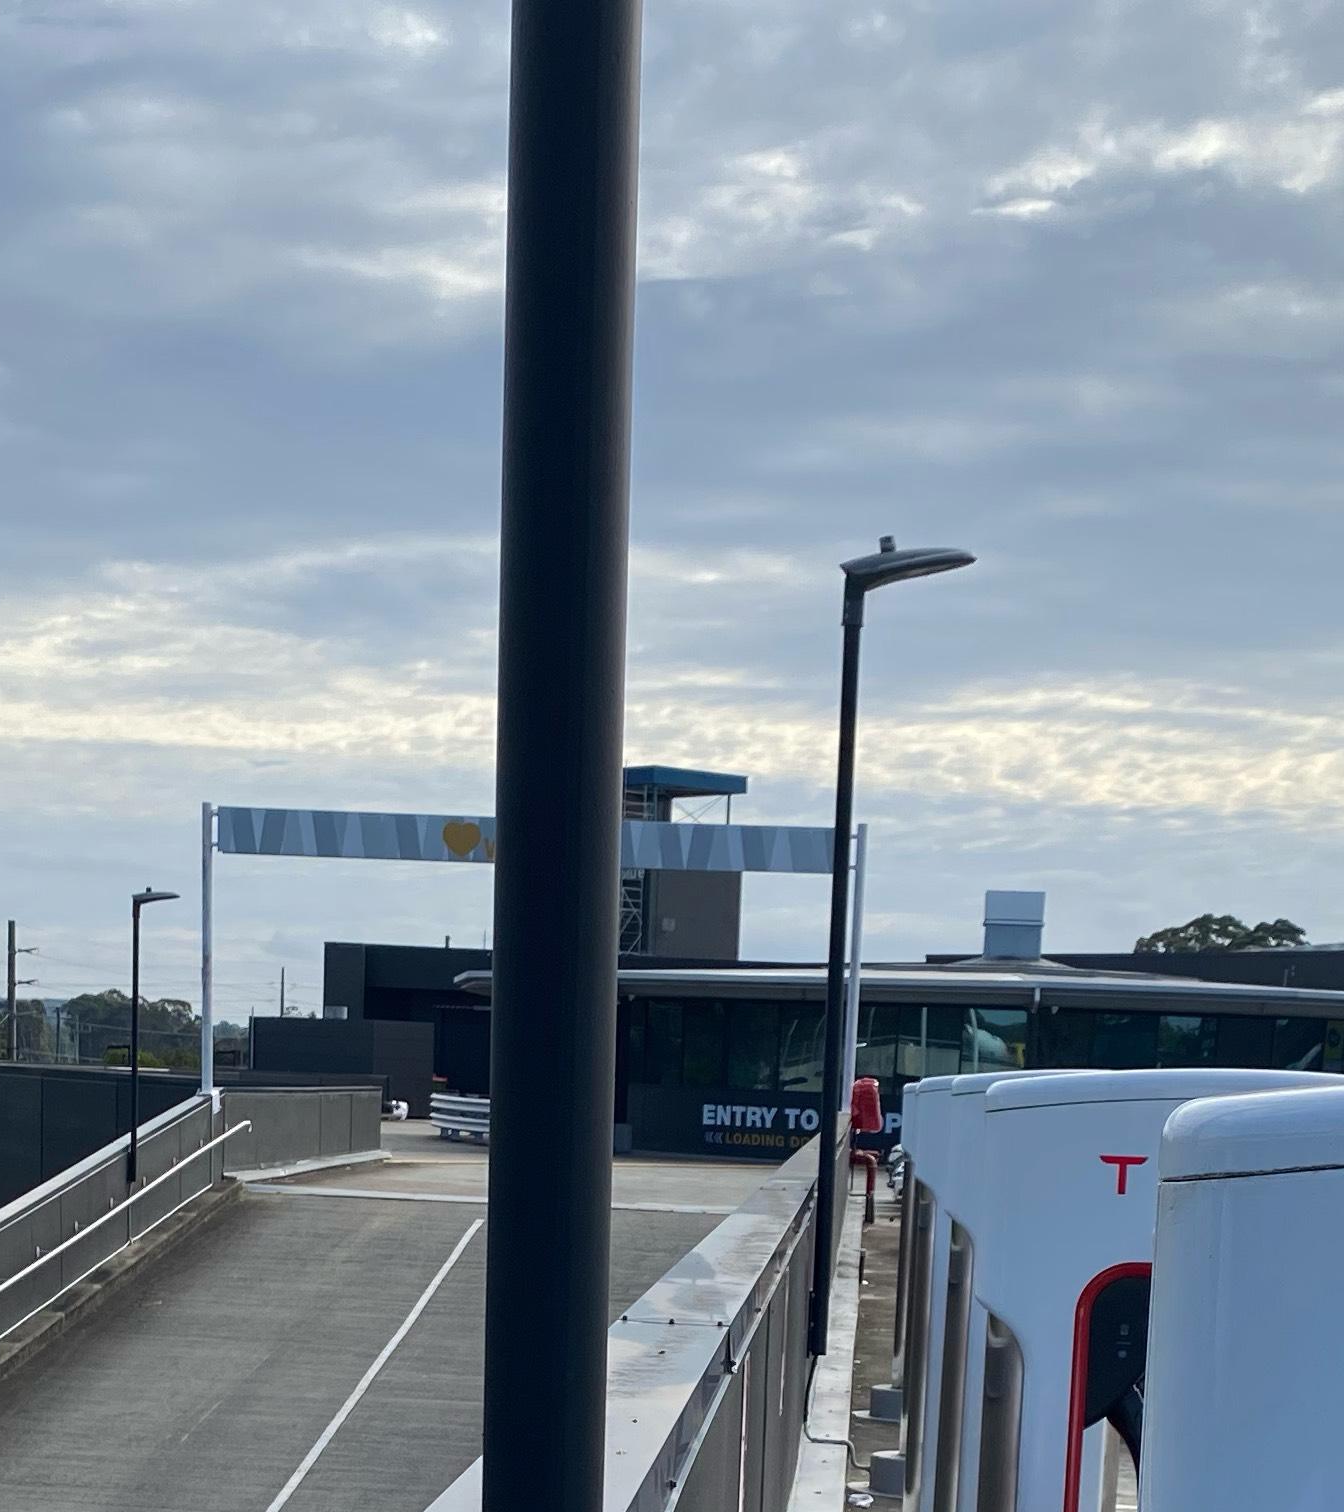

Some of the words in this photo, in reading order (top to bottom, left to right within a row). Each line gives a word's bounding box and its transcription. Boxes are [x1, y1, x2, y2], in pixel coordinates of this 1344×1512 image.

[702, 1104, 778, 1129] ENTRY
[784, 1108, 820, 1131] TO
[724, 1132, 785, 1148] LOADING
